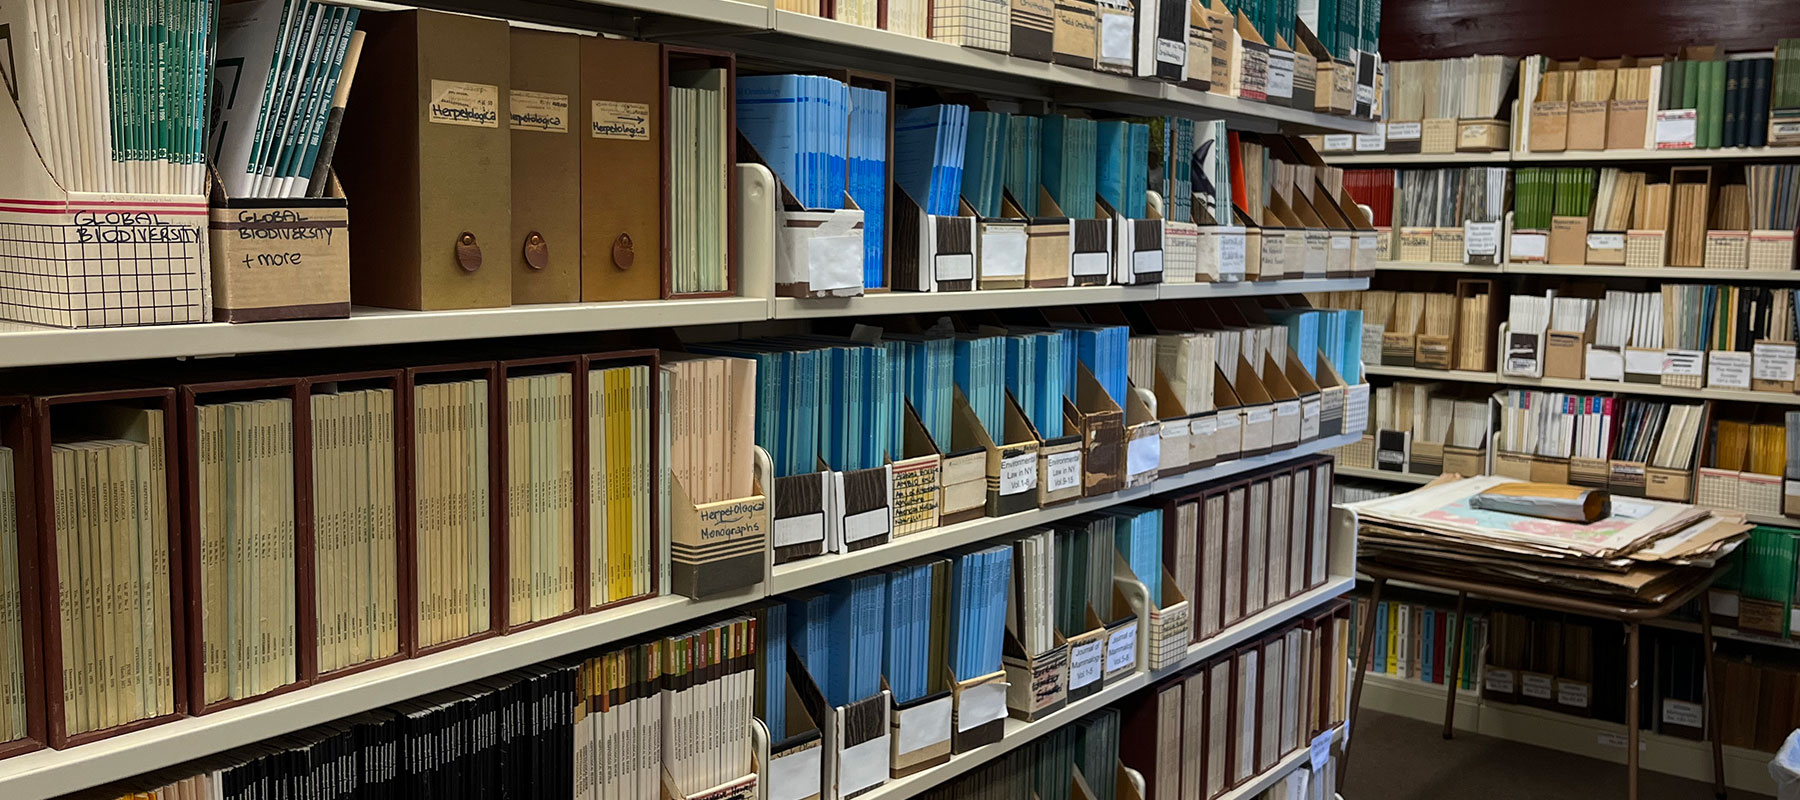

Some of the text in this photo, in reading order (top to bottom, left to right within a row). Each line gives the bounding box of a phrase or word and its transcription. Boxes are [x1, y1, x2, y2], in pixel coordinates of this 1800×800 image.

[342, 21, 353, 37] GLOBAL
[335, 38, 349, 66] BIODIVERSITY
[157, 92, 165, 107] Spring
[432, 103, 496, 125] Herpetologica
[510, 112, 561, 130] erpetologica
[593, 121, 645, 137] Herpetologica
[74, 210, 169, 226] GLOBAL
[238, 210, 308, 223] GLOBAL
[78, 228, 200, 243] BIODIVERSITY
[239, 228, 333, 245] BIODIVERSITY
[258, 251, 302, 267] more
[701, 523, 759, 540] Monographs
